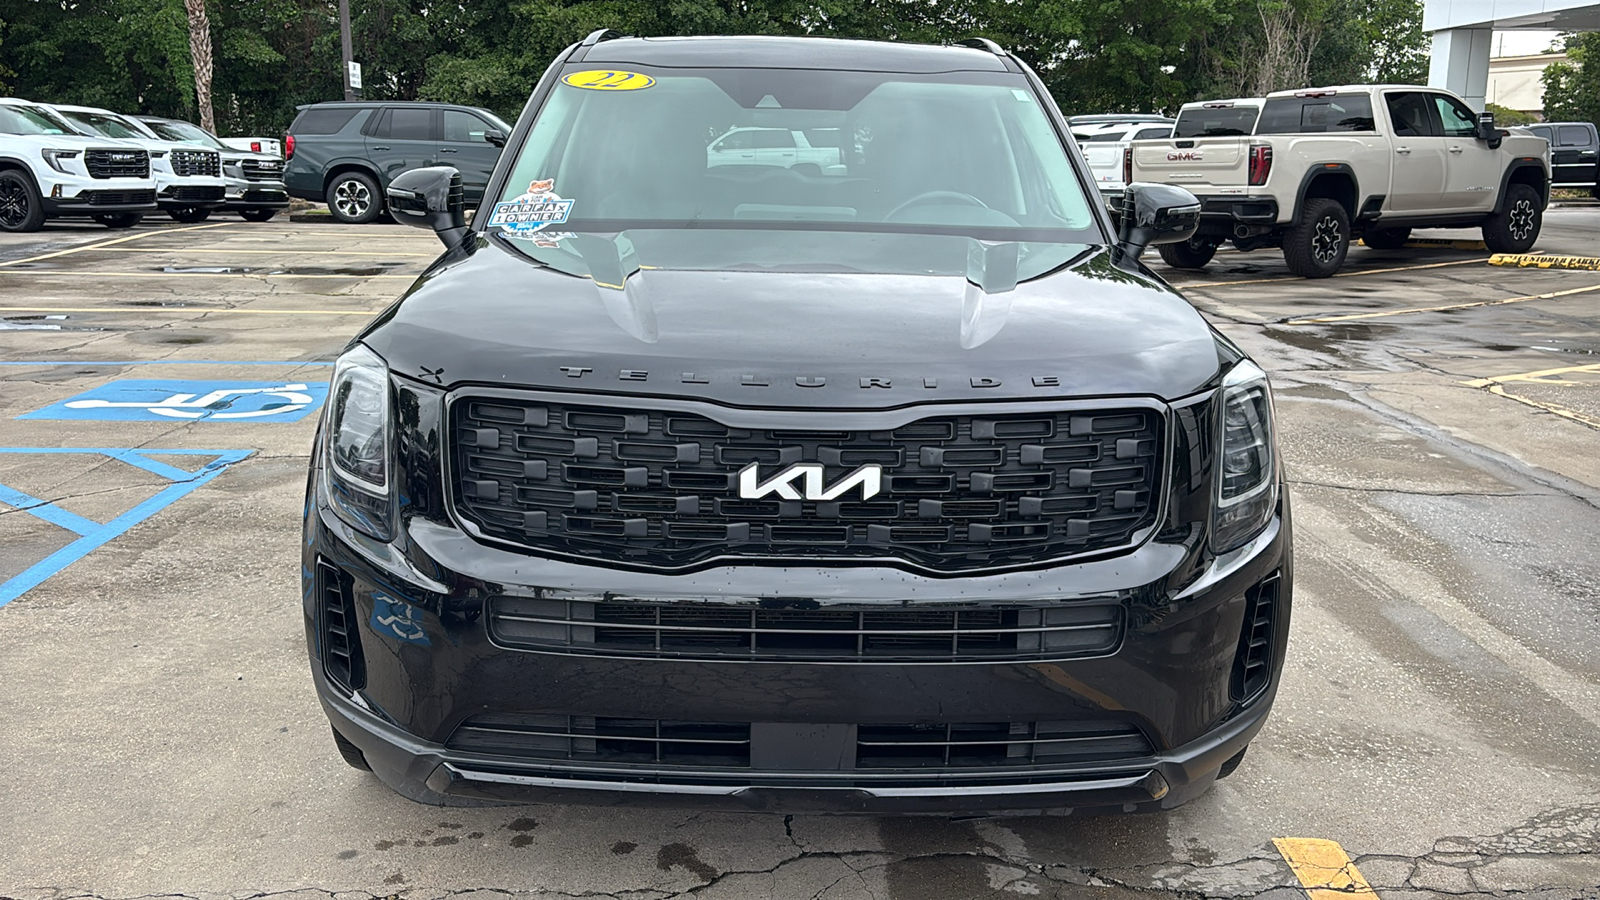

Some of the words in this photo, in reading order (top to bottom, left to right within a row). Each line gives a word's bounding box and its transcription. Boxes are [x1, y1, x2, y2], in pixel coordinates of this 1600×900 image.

[580, 72, 635, 88] 22
[1166, 152, 1204, 161] GMC
[498, 204, 566, 213] CARFAX
[504, 213, 564, 222] OWNER
[559, 366, 1060, 388] TELLURIDE
[739, 462, 882, 501] KIA
